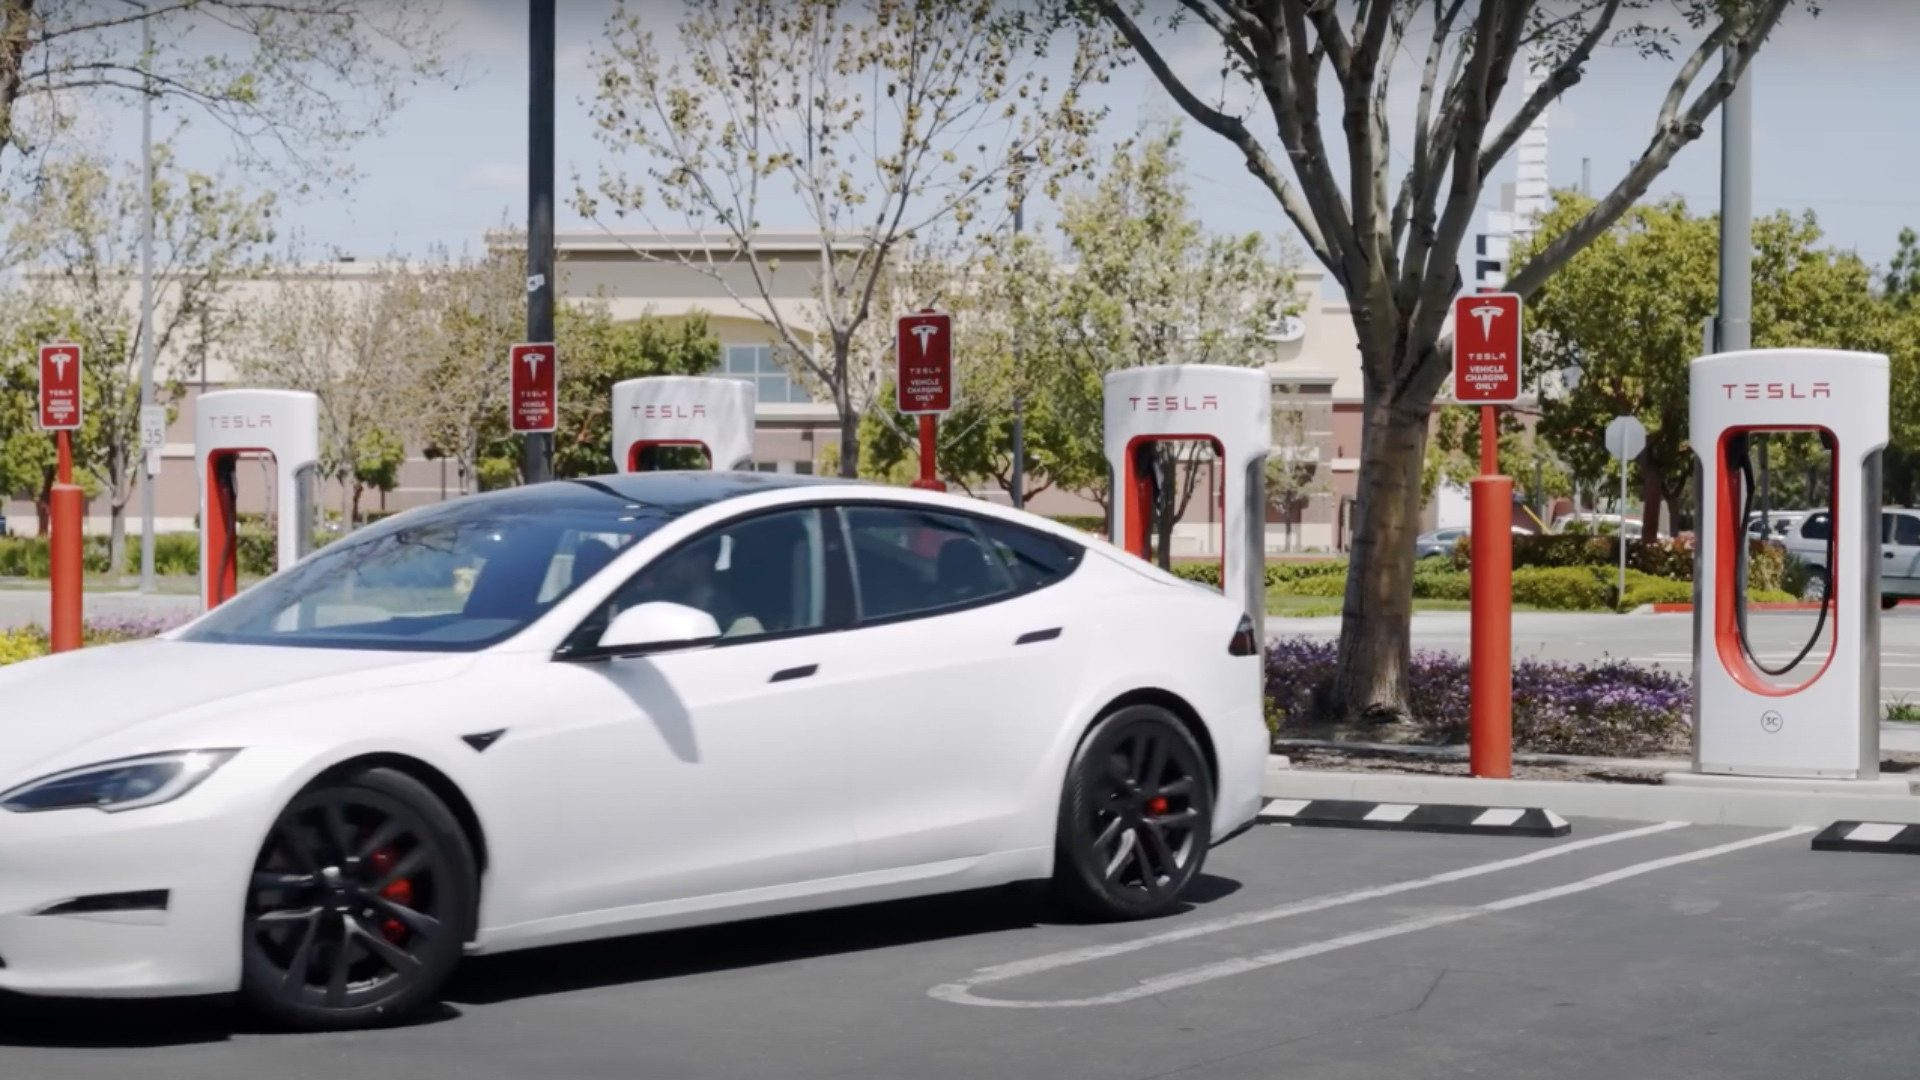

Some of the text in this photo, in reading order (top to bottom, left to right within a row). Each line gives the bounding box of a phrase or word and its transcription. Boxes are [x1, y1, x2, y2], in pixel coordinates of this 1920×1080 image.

[1467, 352, 1507, 361] TESLA
[909, 367, 942, 375] TESLA
[1469, 365, 1505, 373] VEHICLE
[910, 378, 940, 386] VEHICLE
[1465, 373, 1509, 382] CHARGING
[906, 386, 943, 394] CHARGING
[1474, 382, 1499, 390] ONLY
[520, 390, 548, 399] TESLA
[1722, 382, 1831, 400] TESLA
[915, 394, 935, 402] ONLY
[1128, 396, 1218, 411] TESLA
[631, 404, 706, 419] TESLA
[208, 415, 272, 429] TESLA
[526, 414, 542, 422] ONLY
[145, 428, 162, 445] 35
